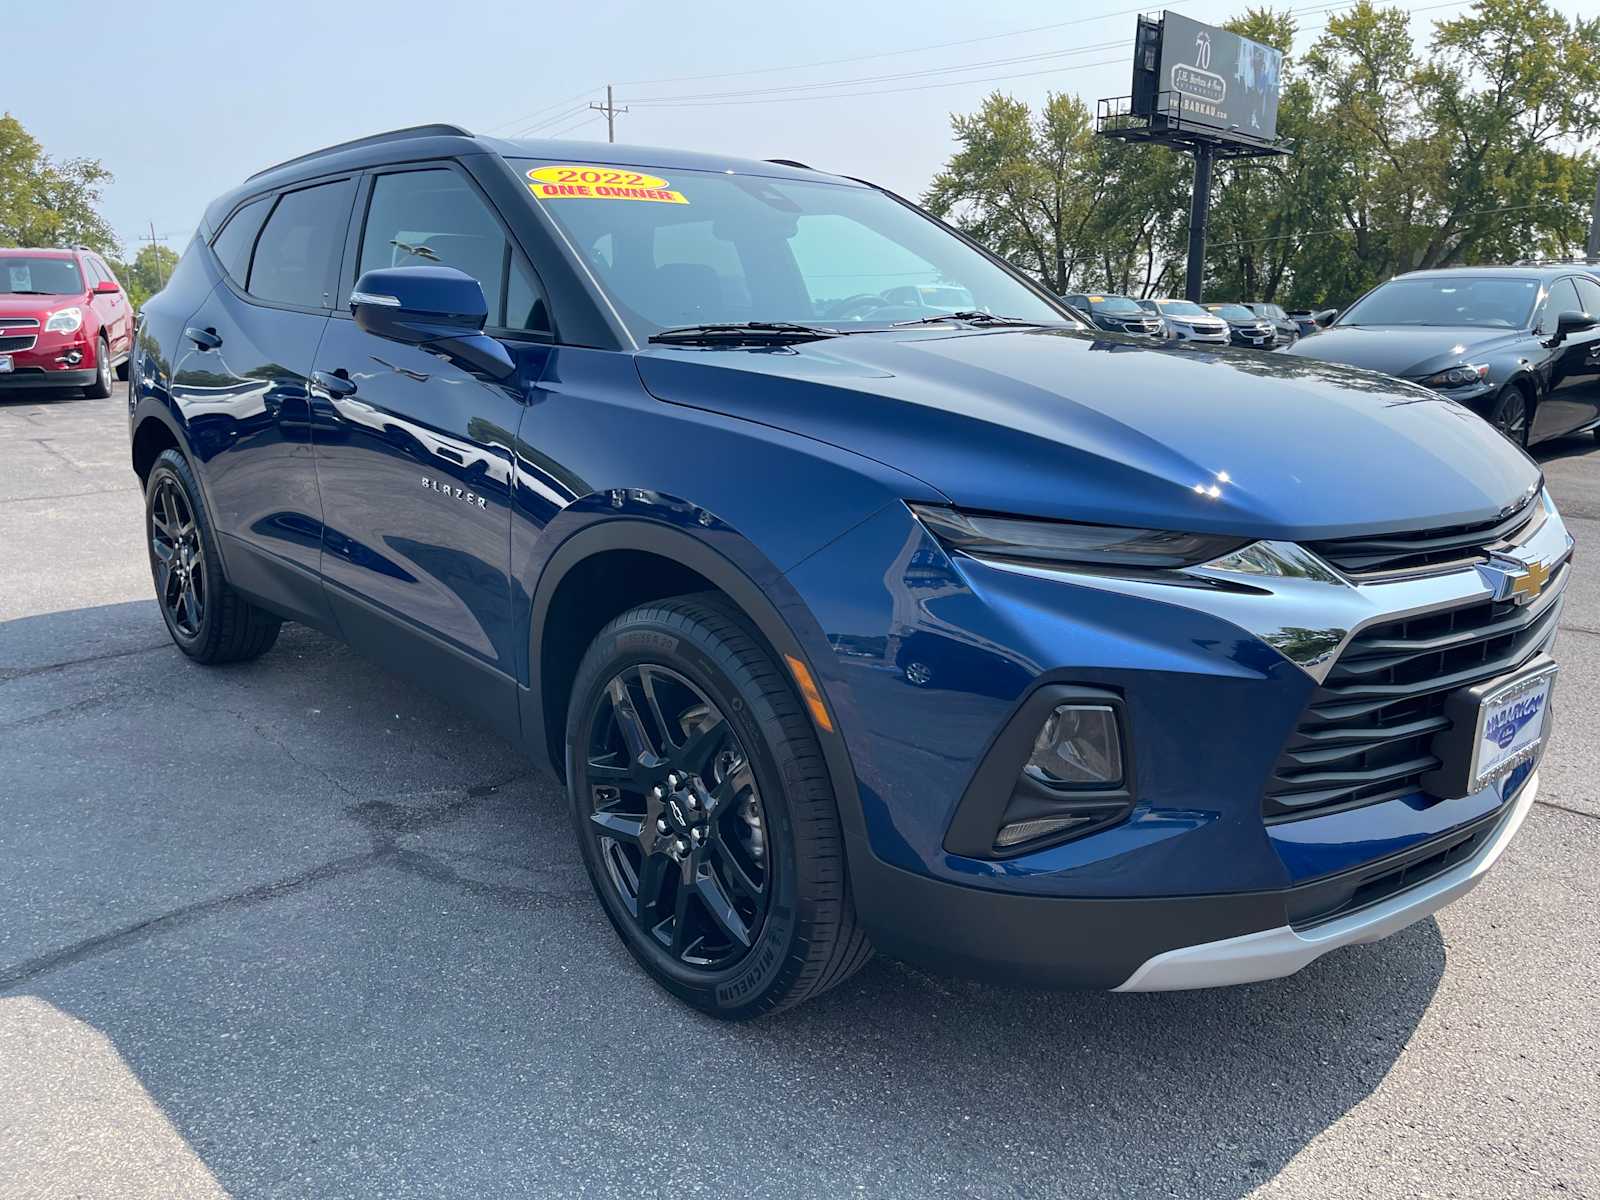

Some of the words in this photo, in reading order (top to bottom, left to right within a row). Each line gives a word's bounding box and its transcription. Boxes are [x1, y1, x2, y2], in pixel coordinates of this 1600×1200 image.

[1195, 38, 1211, 69] 70
[543, 184, 591, 196] ONE
[595, 186, 676, 201] OWNER
[557, 170, 645, 186] 2022
[421, 476, 488, 511] BLAZER
[718, 946, 775, 1001] MICHELIN
